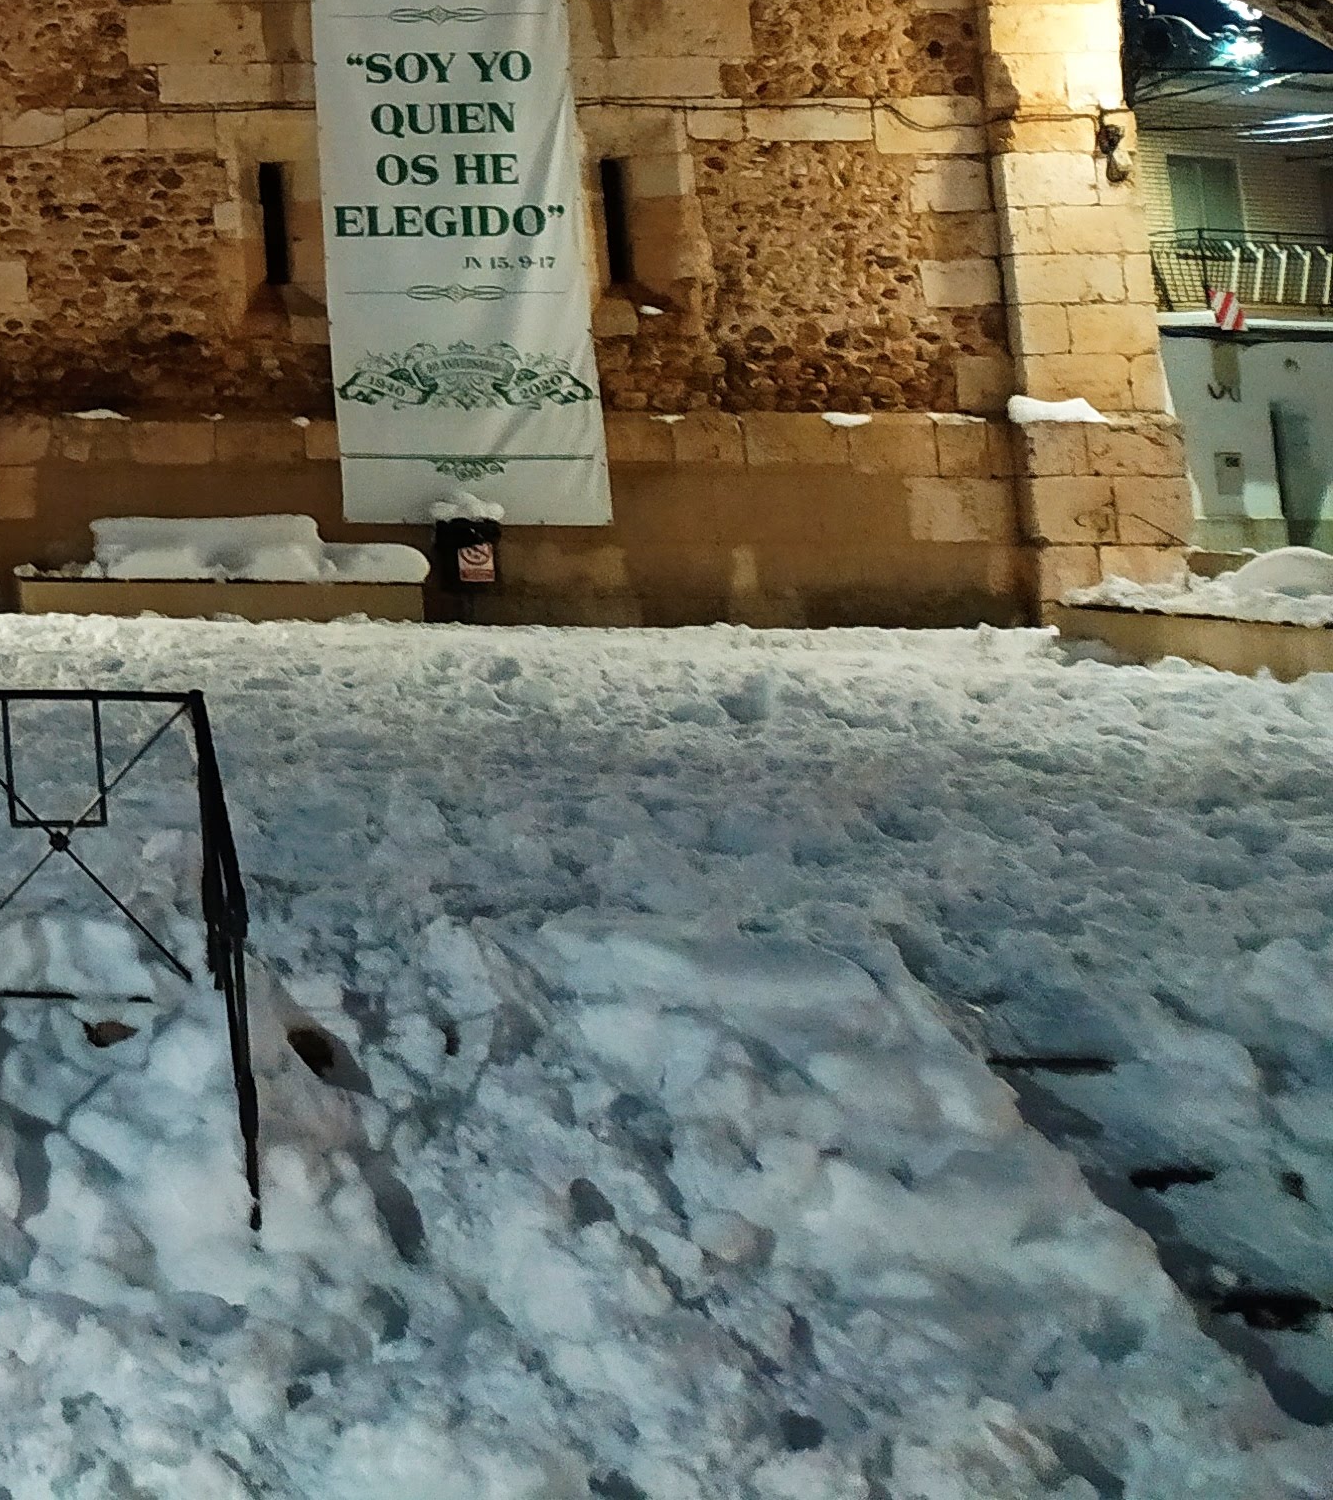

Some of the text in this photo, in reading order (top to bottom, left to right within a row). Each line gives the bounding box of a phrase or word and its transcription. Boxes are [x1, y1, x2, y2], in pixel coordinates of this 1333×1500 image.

[346, 50, 532, 84] “SOY YO
[371, 102, 516, 138] QUIEN
[376, 153, 519, 186] OS HE
[334, 204, 565, 238] ELEGIDO”
[462, 256, 482, 269] JN
[518, 255, 556, 269] 9-17
[519, 374, 562, 399] 2020
